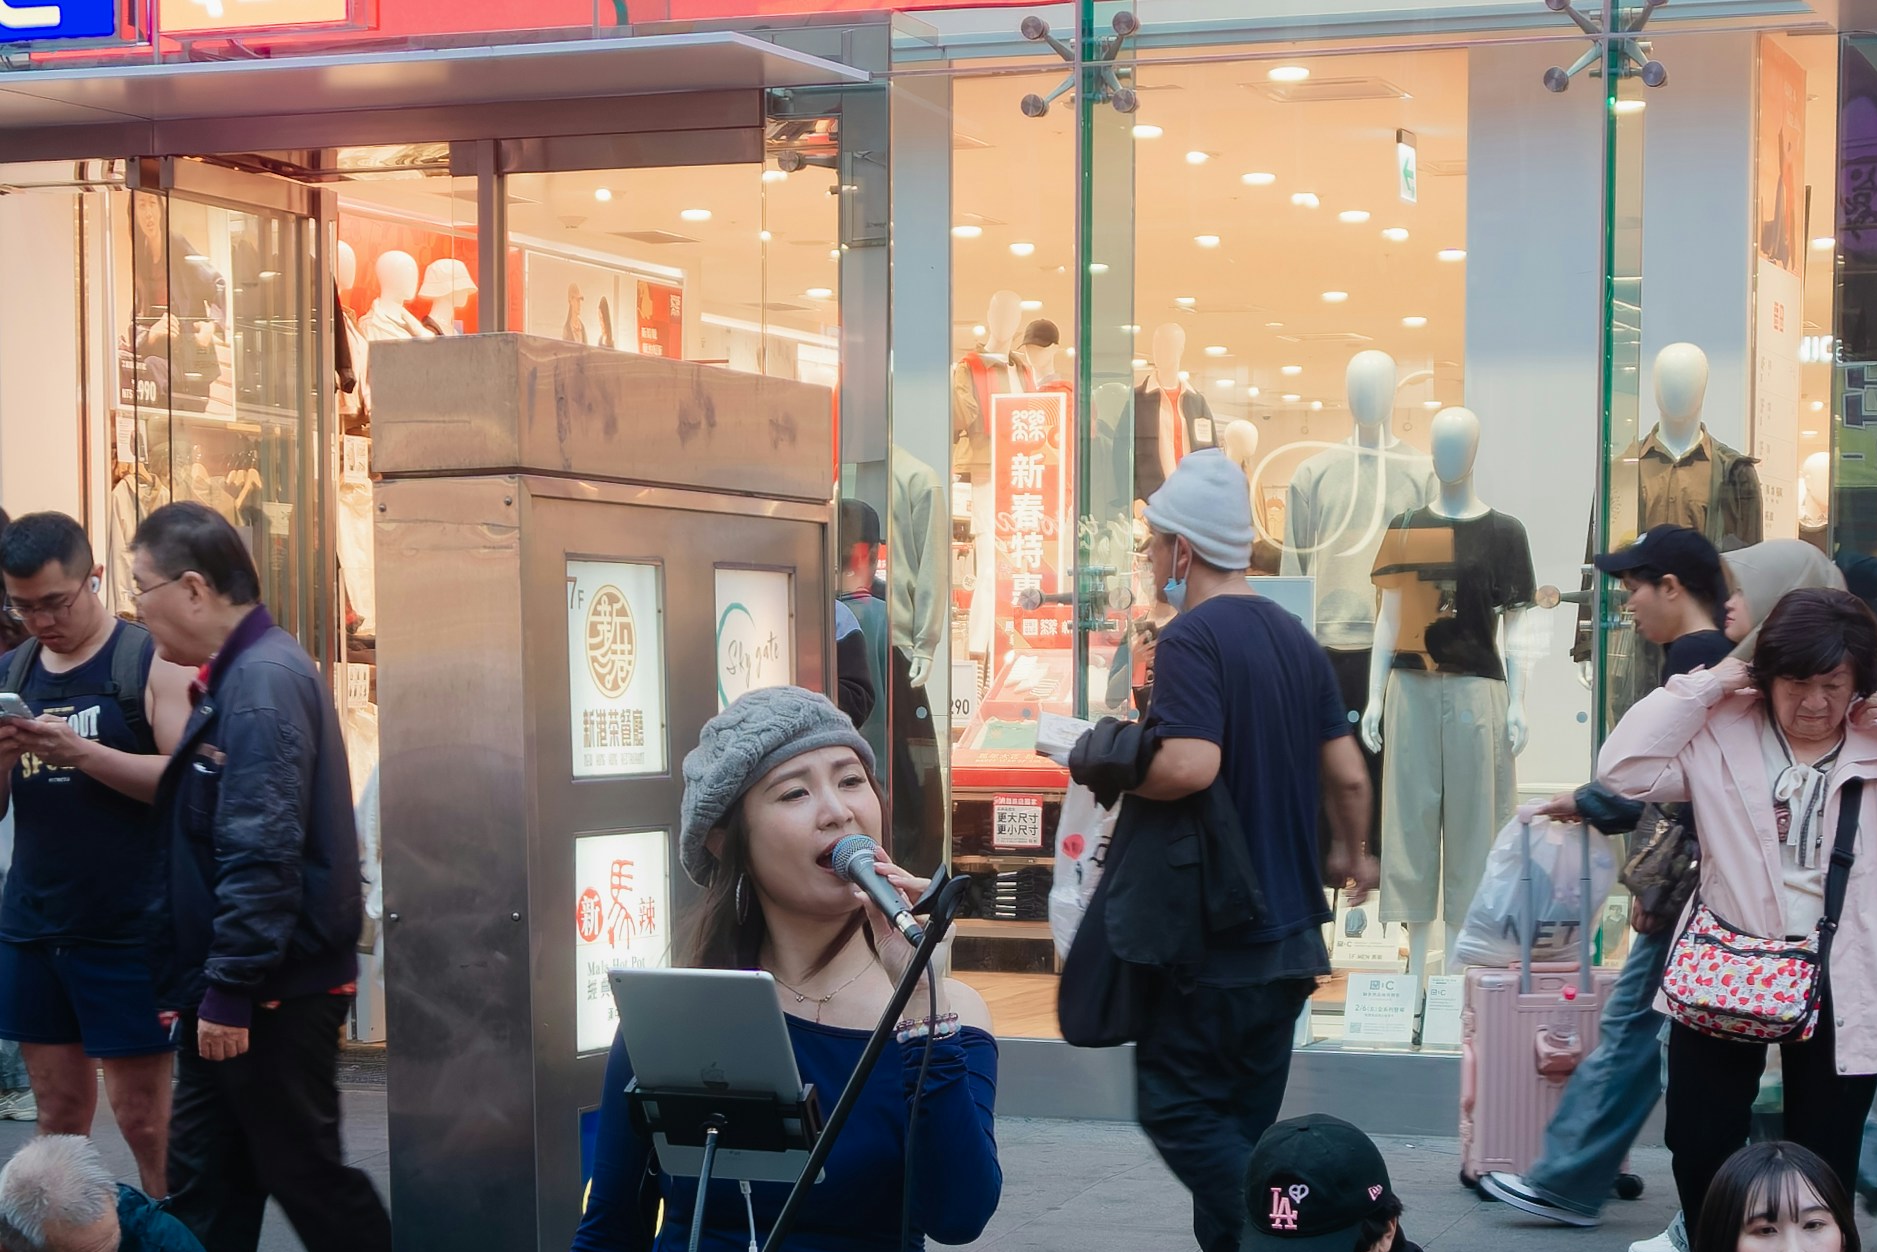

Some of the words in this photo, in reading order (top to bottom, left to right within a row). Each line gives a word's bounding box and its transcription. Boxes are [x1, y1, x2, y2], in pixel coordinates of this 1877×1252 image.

[726, 639, 751, 688] Sky
[755, 631, 780, 679] gate
[583, 708, 645, 748] 新港茶餐廳
[997, 811, 1039, 824] 更大尺寸
[997, 823, 1039, 836] 更小尺寸
[1502, 914, 1581, 948] NET
[1269, 1187, 1298, 1230] LA
